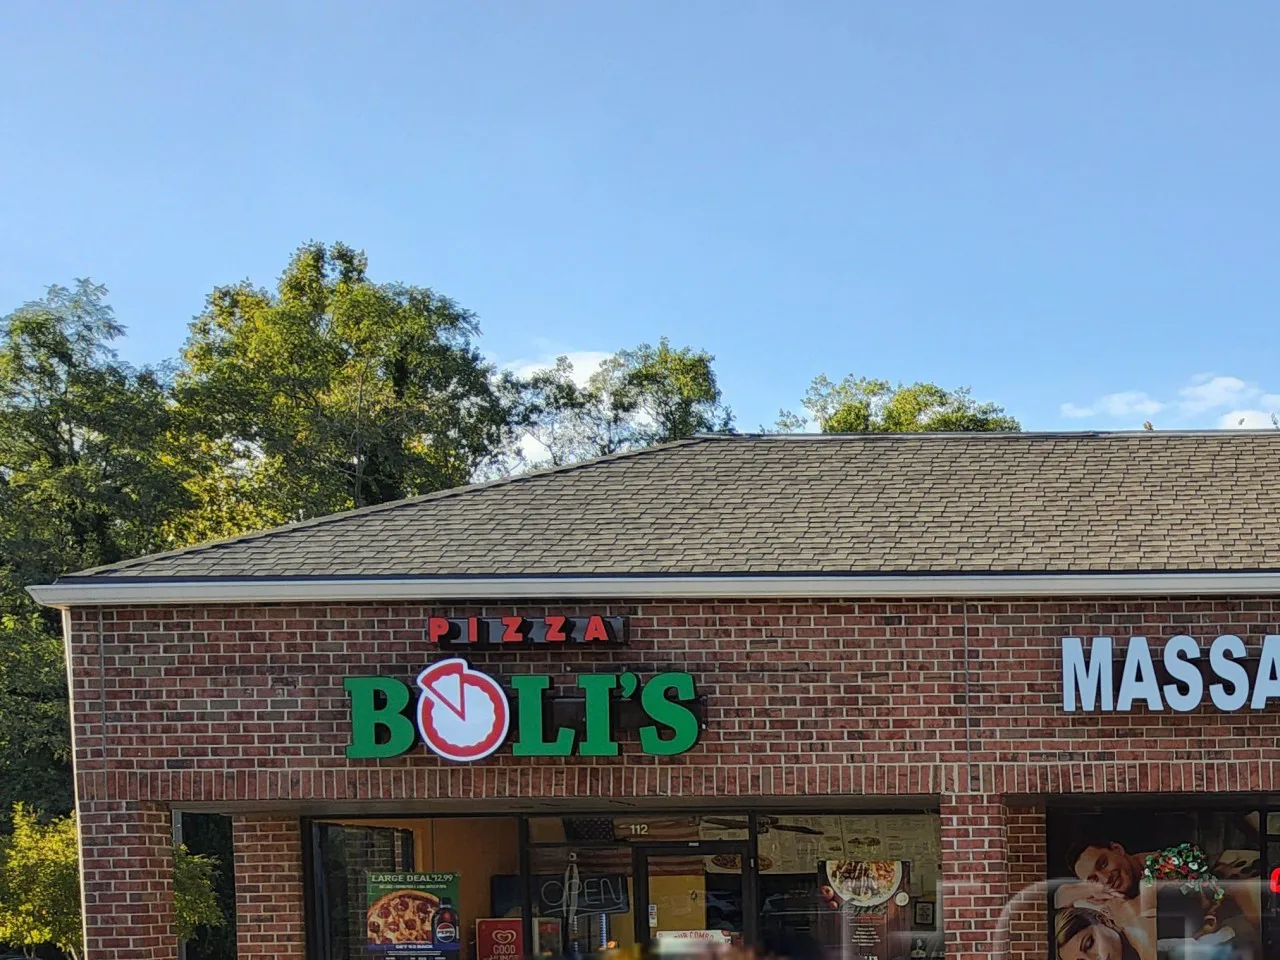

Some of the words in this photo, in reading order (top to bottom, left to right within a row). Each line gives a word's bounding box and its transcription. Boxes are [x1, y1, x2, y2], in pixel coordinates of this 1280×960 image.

[428, 615, 609, 642] PIZZA
[629, 824, 648, 835] 112
[371, 874, 404, 882] LARGE
[406, 874, 432, 882] DEAL
[541, 876, 623, 905] OPEN
[493, 945, 515, 954] GOOD
